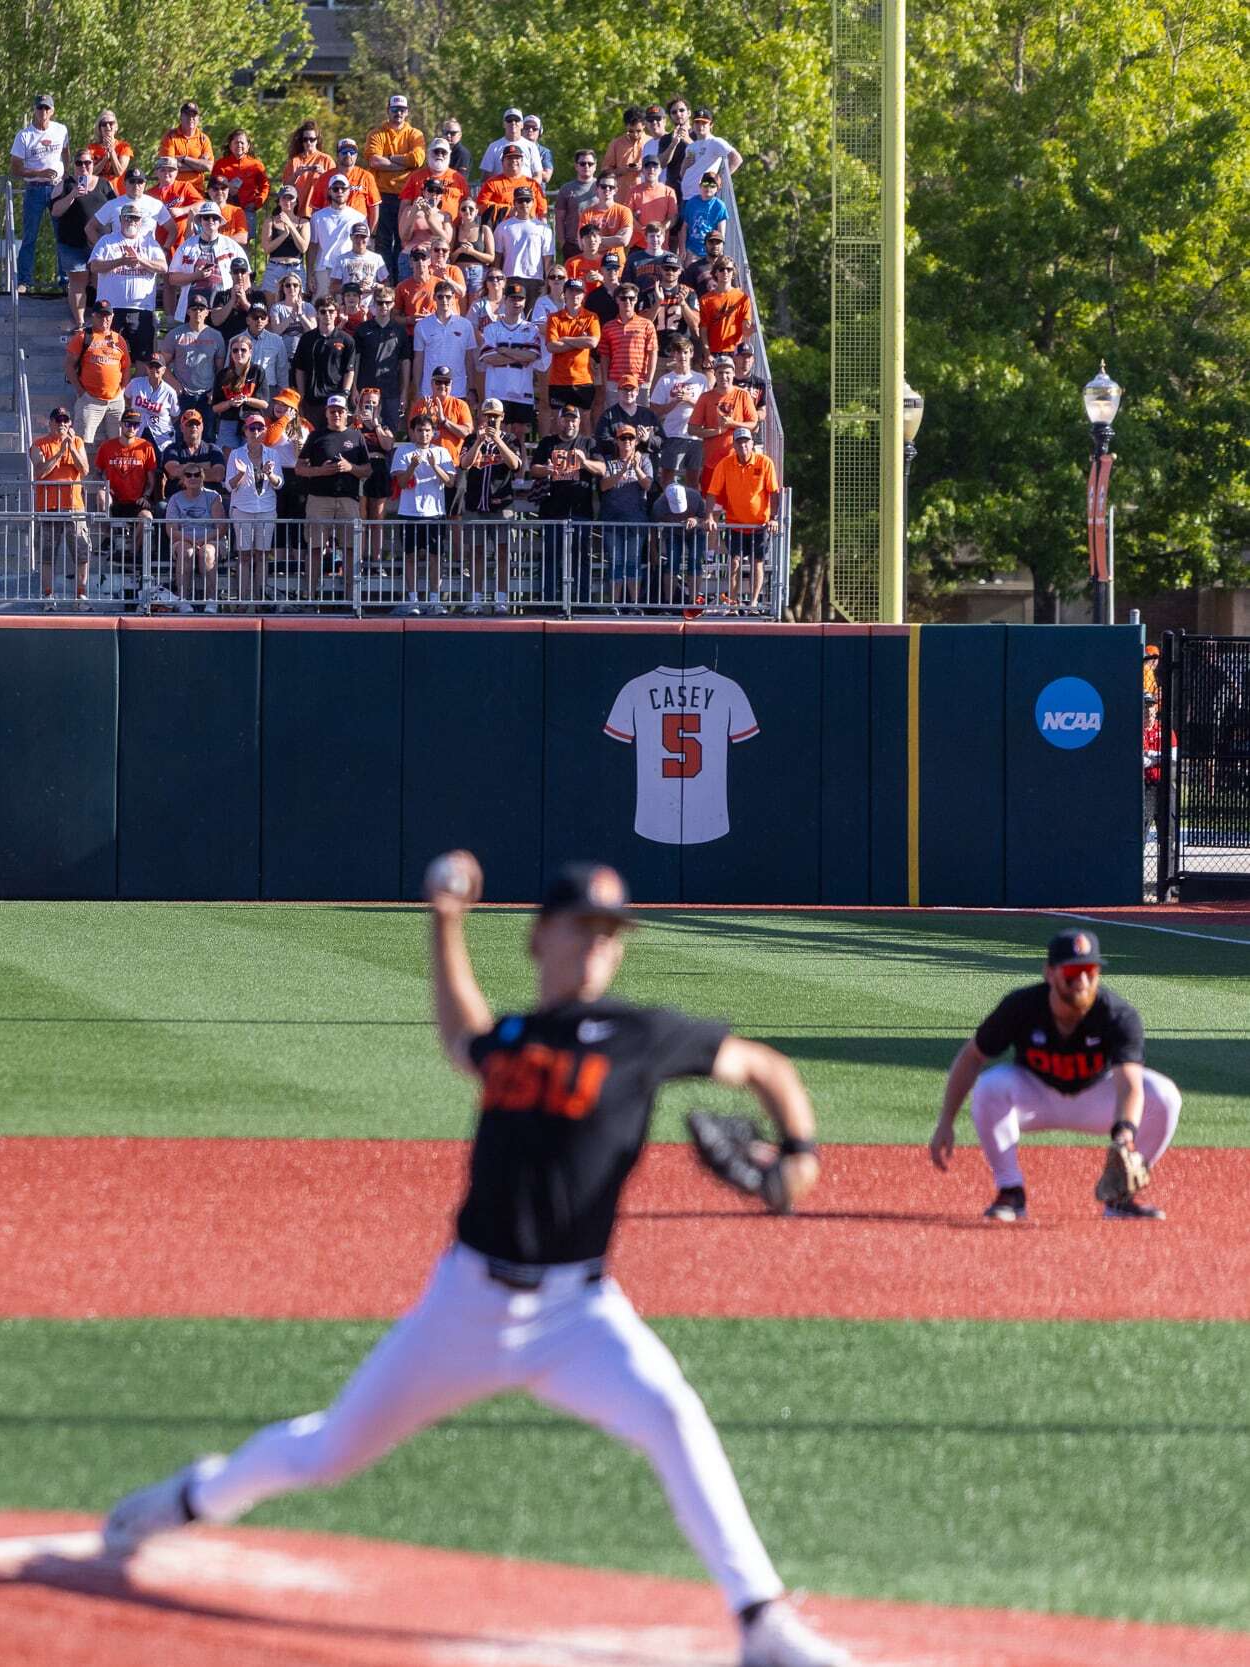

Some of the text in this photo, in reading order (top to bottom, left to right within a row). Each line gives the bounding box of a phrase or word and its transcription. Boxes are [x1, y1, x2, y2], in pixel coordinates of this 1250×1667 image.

[649, 686, 714, 710] CASEY
[1042, 711, 1101, 731] NCAA
[662, 713, 702, 778] 5
[1025, 1049, 1104, 1081] OSU
